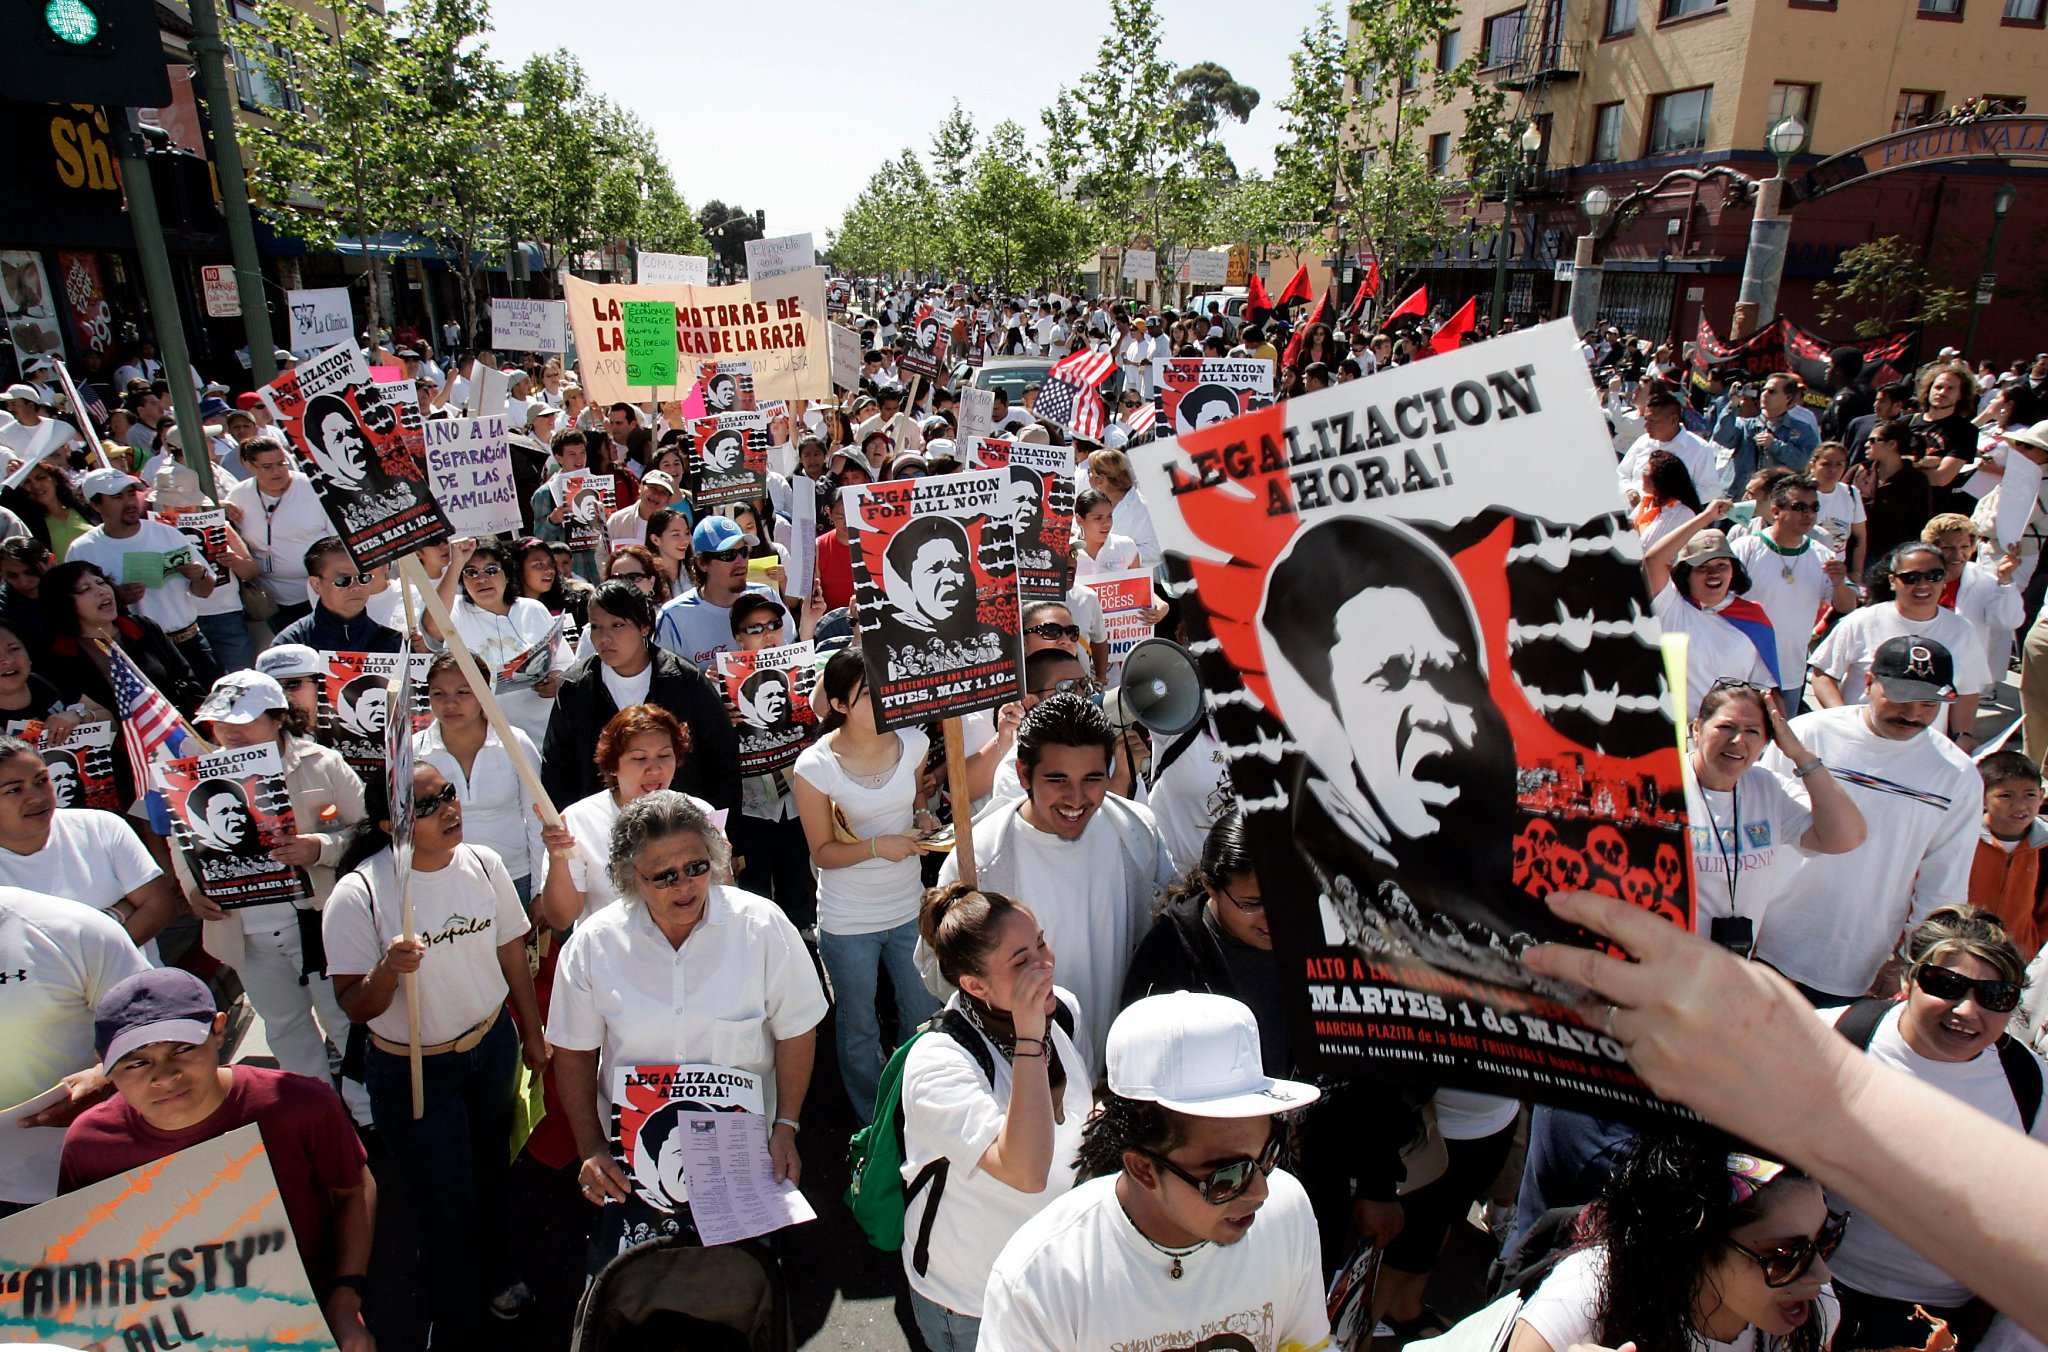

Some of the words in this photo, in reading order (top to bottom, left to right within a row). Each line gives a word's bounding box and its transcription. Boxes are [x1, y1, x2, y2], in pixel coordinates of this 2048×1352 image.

[1883, 124, 2048, 166] FRUITVALE
[206, 269, 218, 280] NO
[777, 296, 801, 319] DE
[313, 316, 324, 334] La
[628, 316, 671, 324] REFUGEE
[495, 327, 511, 335] PARA
[519, 328, 540, 338] TODOS
[626, 338, 640, 347] US
[757, 323, 806, 350] RAZA
[775, 355, 809, 372] JUSTA
[1162, 364, 1266, 374] LEGALIZATION
[268, 348, 353, 403] LEGALIZATION
[279, 392, 301, 411] FOR
[302, 380, 326, 399] ALL
[327, 363, 356, 386] NOW!
[1168, 374, 1196, 383] FOR
[1200, 374, 1227, 383] ALL
[1231, 373, 1263, 383] NOW!
[470, 422, 483, 440] A
[489, 418, 504, 437] LA
[1162, 362, 1542, 497] LEGALIZACION
[429, 442, 507, 472] SEPARACIÓN
[977, 443, 1067, 460] LEGALIZATION
[982, 452, 1006, 461] FOR
[1010, 456, 1033, 464] ALL
[1036, 458, 1065, 468] NOW!
[437, 473, 458, 491] DE
[473, 468, 500, 490] LAS
[1266, 442, 1454, 517] AHORA!
[436, 474, 516, 513] FAMILIAS!
[857, 478, 1000, 507] LEGALIZATION
[867, 504, 907, 520] FOR
[913, 500, 949, 514] ALL
[954, 493, 998, 509] NOW!
[353, 536, 384, 554] TUES,
[385, 525, 408, 542] MAY
[408, 520, 417, 531] 1,
[1095, 584, 1120, 597] TECT
[1100, 594, 1134, 609] OCESS
[1104, 614, 1138, 628] ensive
[1113, 626, 1152, 639] Reform
[328, 655, 426, 667] LEGALIZAON
[725, 645, 808, 664] LEGALIZACION
[748, 657, 791, 670] AHORA!
[880, 685, 895, 695] END
[900, 674, 944, 691] DETENTIONS
[947, 670, 961, 681] AND
[965, 660, 1015, 679] DEPORTATIONS!
[882, 688, 933, 709] TUES,
[936, 680, 973, 697] MAY
[976, 677, 987, 689] 1,
[160, 748, 268, 775] LEGALIZACION
[189, 763, 245, 781] AHORA!
[740, 757, 768, 767] ARTES,
[1695, 848, 1774, 873] ALIFORNI
[422, 917, 491, 949] Acapulco
[1306, 957, 1346, 981] ALTO
[1353, 960, 1364, 980] A
[1370, 965, 1397, 986] LAS
[1308, 985, 1456, 1027] MARTES,
[1459, 1002, 1477, 1029] 1
[1482, 1008, 1518, 1037] de
[1520, 1014, 1627, 1064] MAYO
[1315, 1020, 1364, 1038] MARCHA
[1367, 1024, 1415, 1042] PLAZITA
[1418, 1028, 1432, 1043] de
[1434, 1031, 1447, 1046] la
[1450, 1032, 1480, 1052] BART
[1482, 1038, 1546, 1068] FRUITVALE
[625, 1071, 754, 1090] LEGALIZACION
[1319, 1043, 1364, 1058] OAKLAND,
[1368, 1047, 1429, 1064] CALIFORNIA,
[1432, 1055, 1455, 1066] 2007
[1477, 1060, 1529, 1081] COALICION
[1533, 1071, 1551, 1084] DIA
[1555, 1076, 1642, 1107] INTERNACIONAL
[1646, 1098, 1668, 1114] DEL
[658, 1085, 730, 1098] AHORA!
[123, 1304, 204, 1352] ALL
